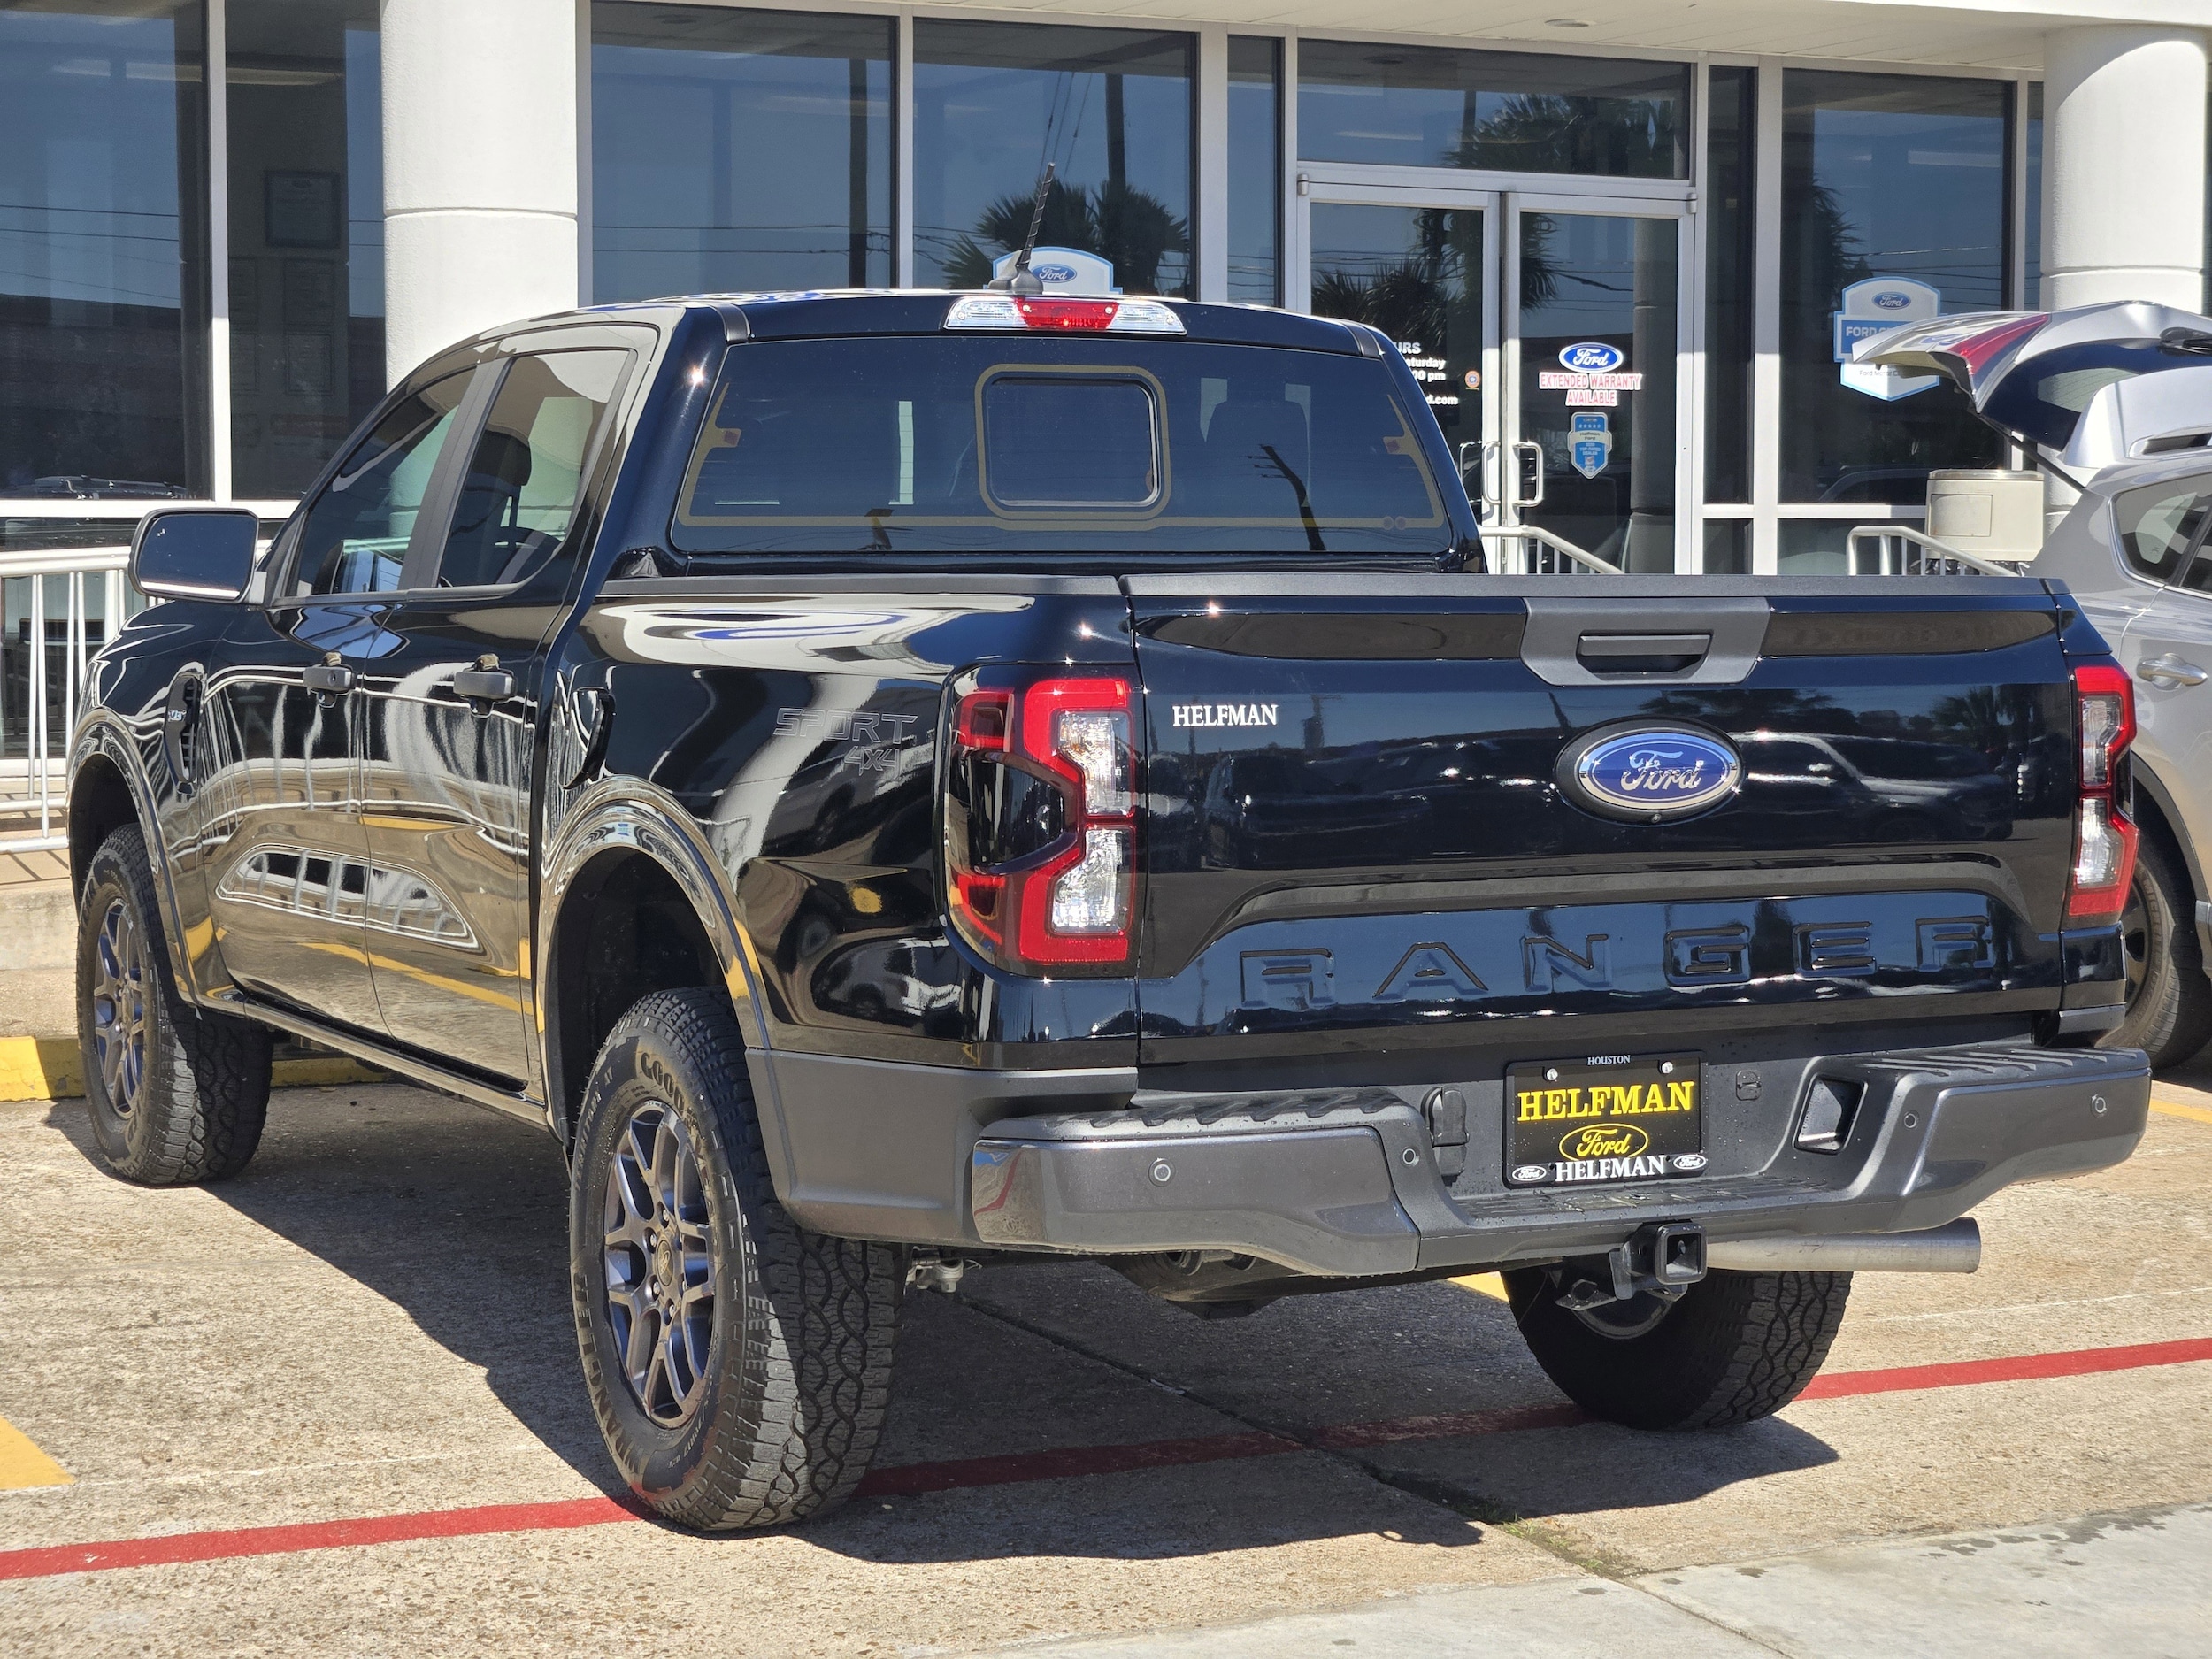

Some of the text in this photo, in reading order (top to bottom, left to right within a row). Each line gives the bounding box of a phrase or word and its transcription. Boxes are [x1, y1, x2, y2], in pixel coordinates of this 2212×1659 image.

[1039, 266, 1069, 281] Ford
[1879, 294, 1903, 307] Ford
[1395, 342, 1422, 355] URS
[1405, 357, 1447, 370] aturday
[1572, 348, 1610, 367] Ford
[1427, 372, 1447, 382] pm
[1540, 374, 1640, 388] EXTENDED WARRANTY
[1426, 394, 1458, 405] d.com
[1567, 391, 1615, 404] AVAILABLE
[1172, 704, 1279, 727] HELFMAN
[772, 708, 918, 745] SPORT
[1620, 749, 1704, 791] Ford
[1240, 915, 1996, 1008] RANGER
[1587, 1054, 1631, 1065] HOUSTON
[1517, 1080, 1695, 1122] HELFMAN
[1576, 1128, 1632, 1157] Ford
[1680, 1155, 1701, 1167] Ford
[1517, 1167, 1540, 1179] Ford
[1555, 1154, 1667, 1183] HELFMAN
